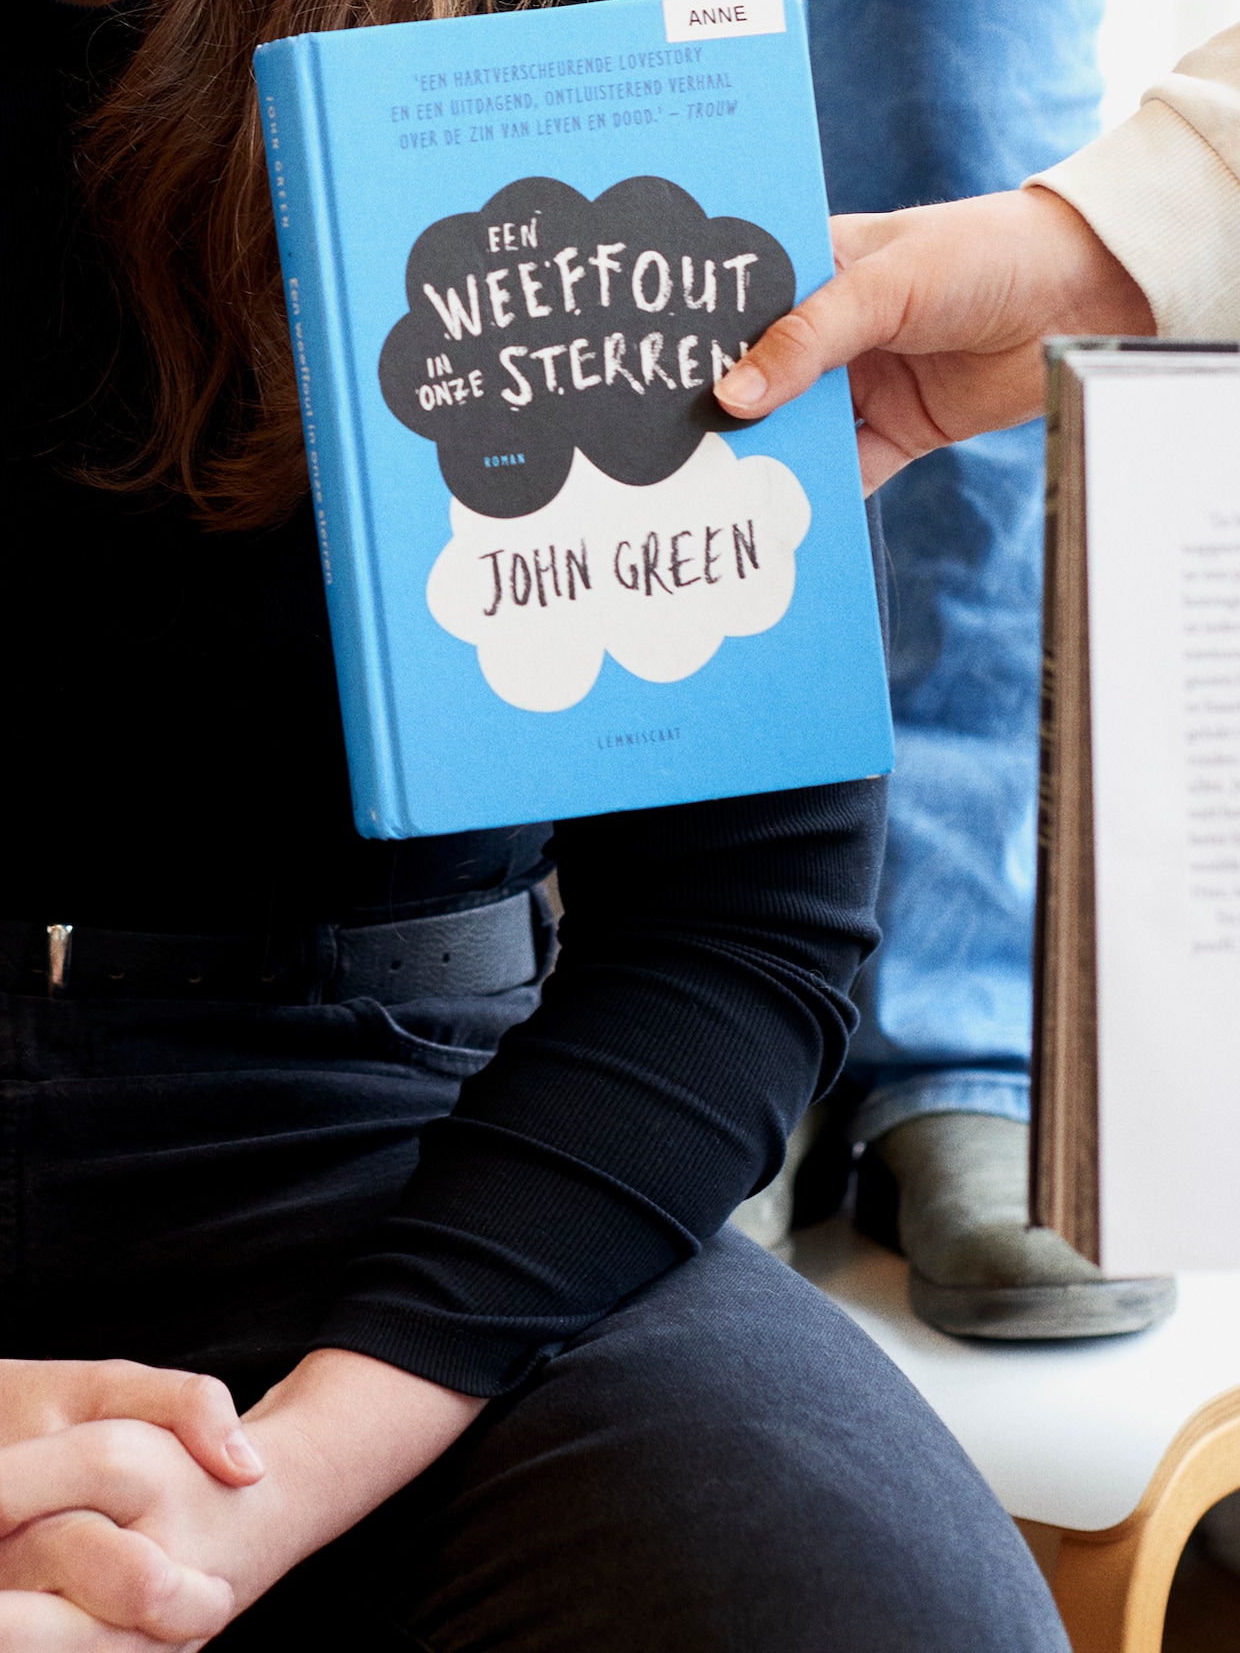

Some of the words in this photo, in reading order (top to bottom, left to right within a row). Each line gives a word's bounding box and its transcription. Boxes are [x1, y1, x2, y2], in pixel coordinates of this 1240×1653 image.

[689, 5, 748, 27] ANNE
[453, 55, 612, 88] HARTVERSCHEURENDE
[618, 47, 703, 71] LOVESTORY
[391, 105, 410, 123] EN
[417, 102, 444, 120] EEN
[450, 93, 539, 117] UITDAGEND,
[544, 81, 662, 107] ONTLUISTEREND
[668, 72, 732, 94] VERHAAL
[399, 131, 438, 150] OVER
[444, 128, 461, 145] DE
[468, 125, 495, 143] ZIN
[501, 120, 530, 139] VAN
[537, 116, 581, 136] LEVEN
[588, 113, 607, 132] EN
[686, 100, 739, 121] TROUW
[265, 95, 280, 150] JOHN
[274, 160, 290, 228] GREEN
[487, 213, 541, 253] EEN
[288, 277, 300, 316] Een
[423, 243, 759, 341] WEEFFOUT
[415, 370, 484, 411] ONZE
[498, 332, 750, 407] STERREN
[426, 353, 453, 379] IN
[483, 453, 526, 468] ROMAN
[479, 538, 592, 616] JOHN
[614, 519, 760, 596] GREEN
[597, 727, 681, 749] LEMNISCAAT
